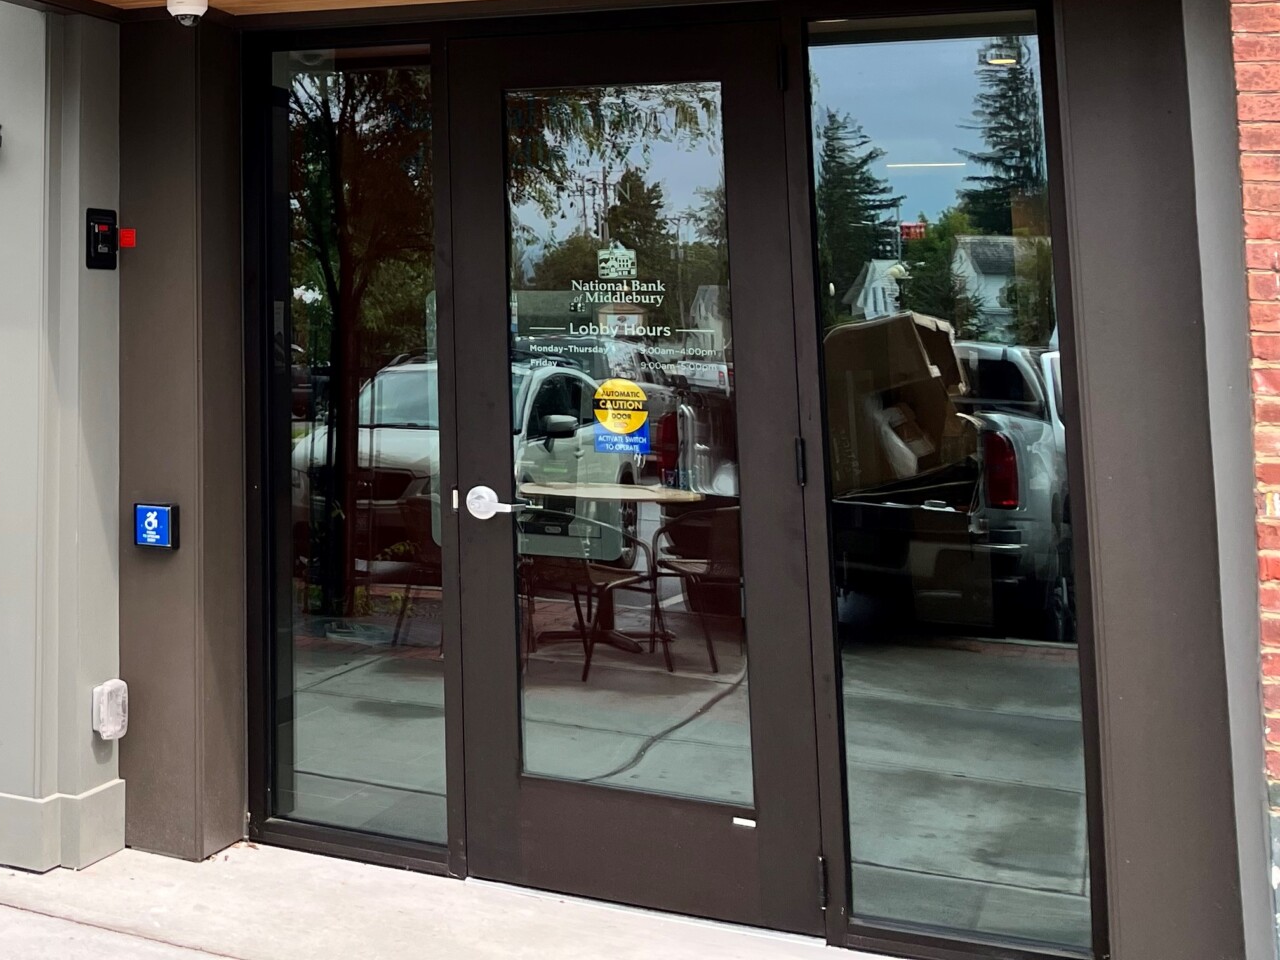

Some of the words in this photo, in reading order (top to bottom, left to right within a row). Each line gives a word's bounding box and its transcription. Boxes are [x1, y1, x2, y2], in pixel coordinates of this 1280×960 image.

[571, 280, 629, 292] National
[631, 280, 666, 292] Bank
[573, 294, 584, 303] of
[585, 291, 664, 307] Middlebury
[569, 322, 619, 337] Lobby
[624, 324, 671, 337] Hours
[530, 358, 558, 368] Friday
[601, 390, 640, 398] AUTOMATIC
[599, 400, 643, 410] CAUTION
[598, 435, 623, 443] ACTIVATE
[625, 436, 647, 444] SWITCH
[615, 443, 639, 451] OPERATE
